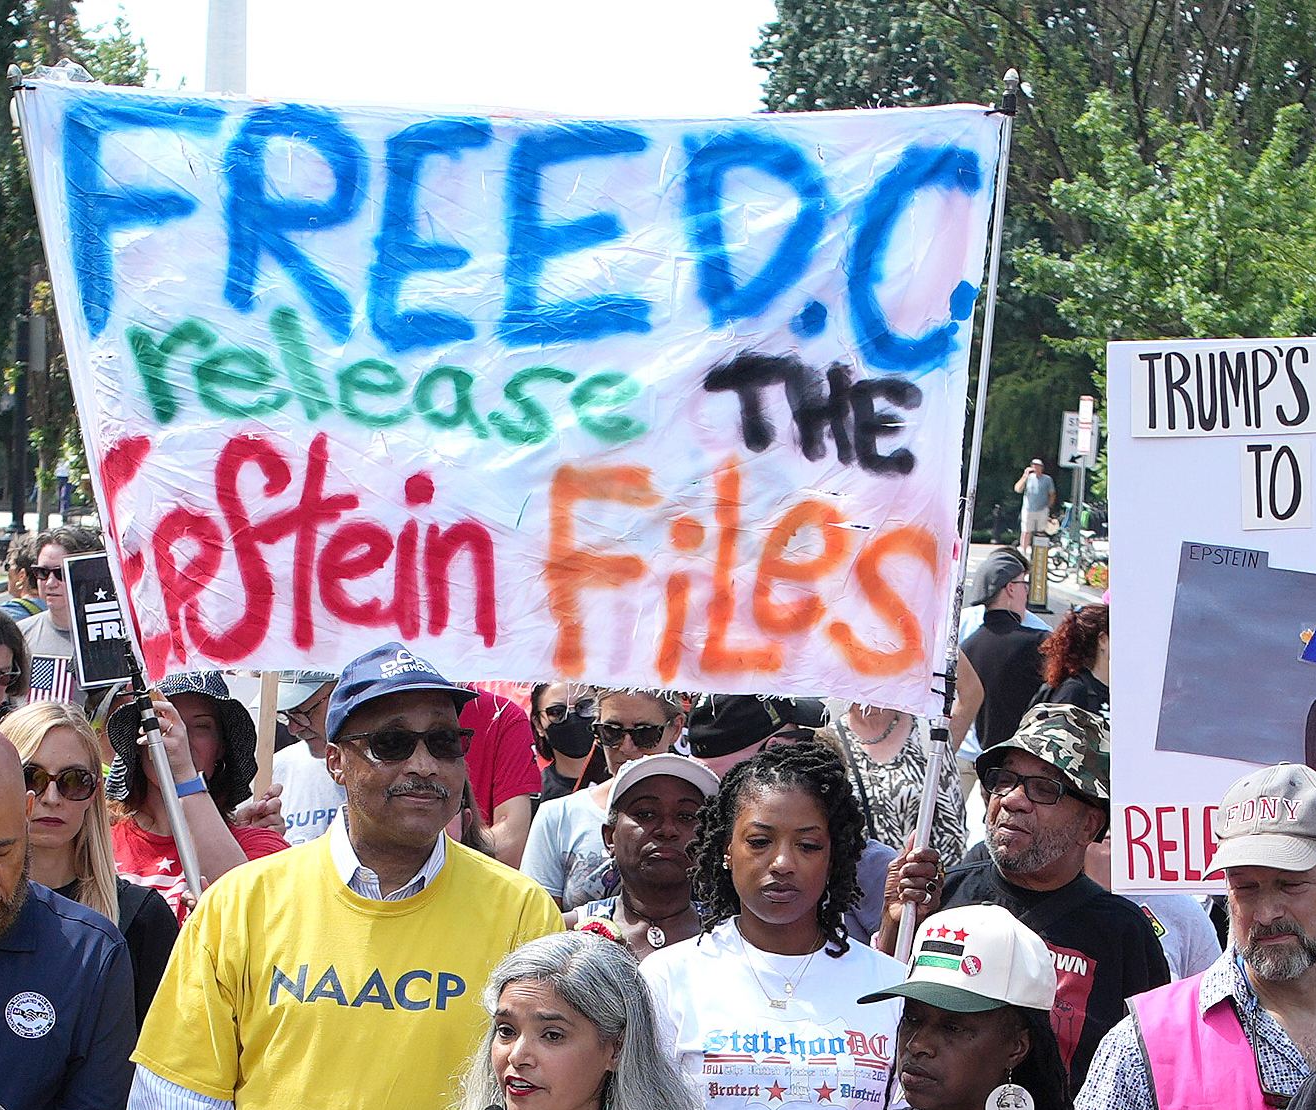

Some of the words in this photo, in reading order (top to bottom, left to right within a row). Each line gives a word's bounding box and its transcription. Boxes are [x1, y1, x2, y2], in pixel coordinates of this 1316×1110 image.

[61, 95, 651, 350] FREE
[685, 128, 980, 371] D.C.
[126, 308, 647, 443] release
[703, 352, 922, 475] THE
[1140, 346, 1309, 431] TRUMP'S
[1246, 444, 1301, 520] TO
[1188, 545, 1260, 569] EPSTEIN
[380, 650, 417, 672] DC
[1224, 797, 1302, 830] FDNY
[269, 964, 466, 1011] NAACP
[708, 1082, 760, 1099] Protect
